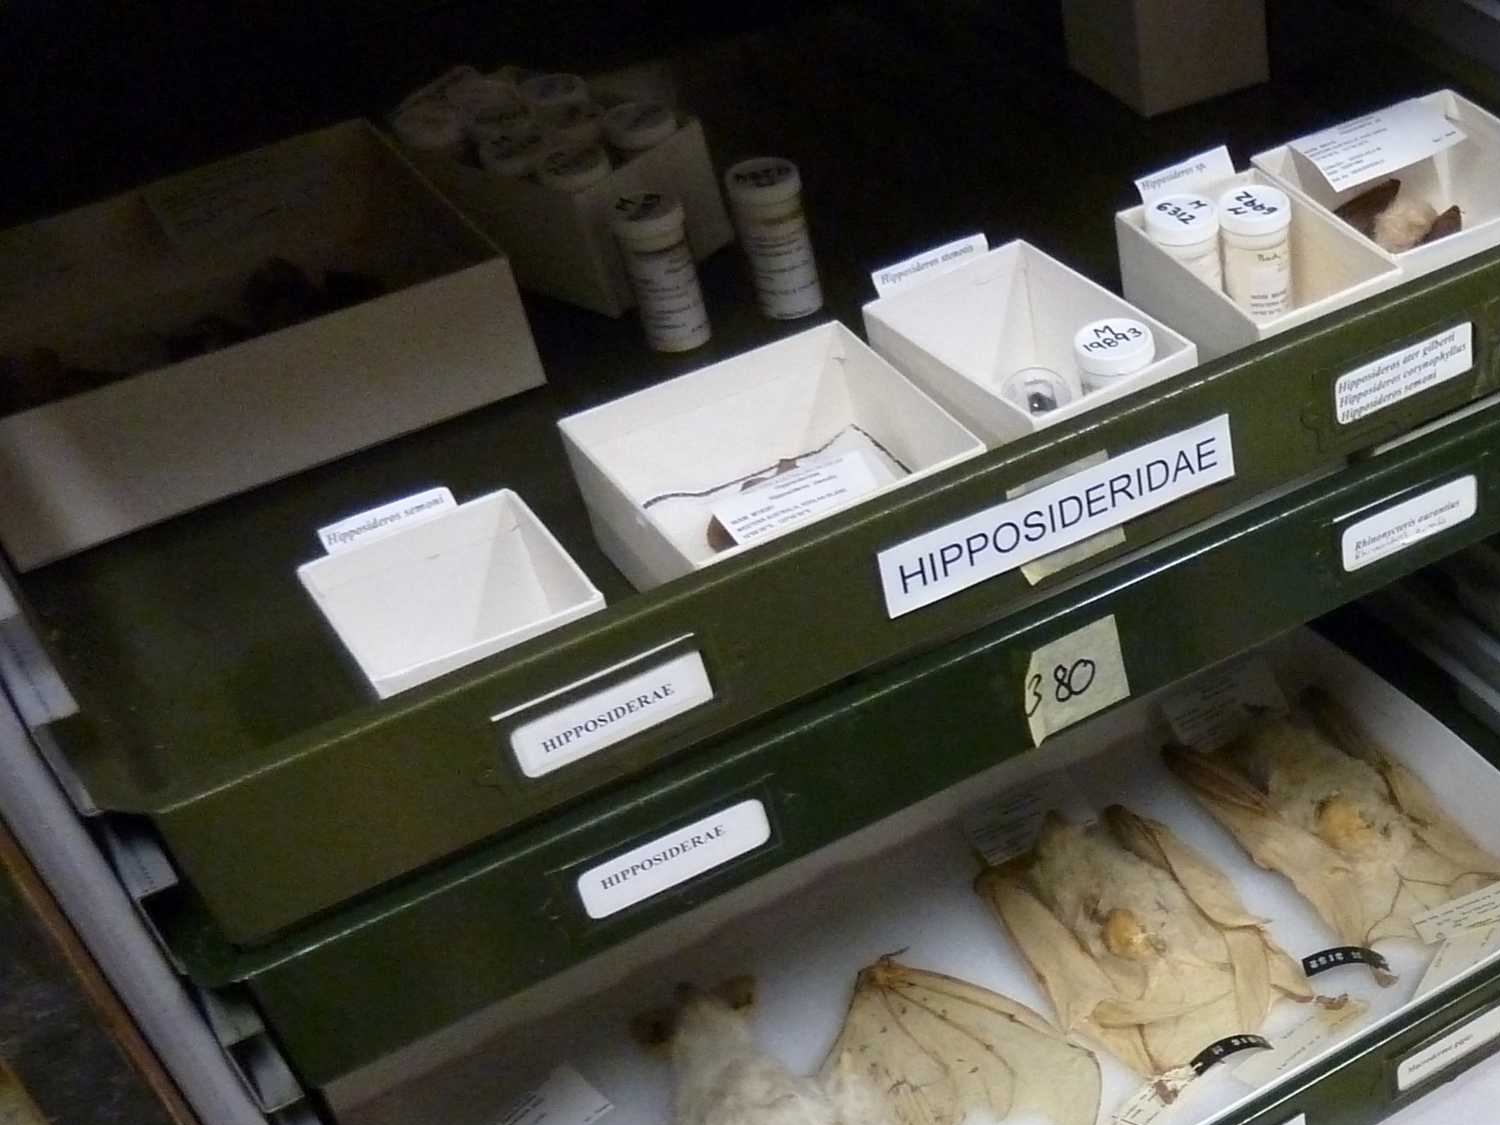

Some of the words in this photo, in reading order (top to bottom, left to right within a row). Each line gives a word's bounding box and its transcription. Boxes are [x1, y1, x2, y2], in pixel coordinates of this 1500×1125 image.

[1156, 202, 1196, 225] 6312
[1083, 327, 1142, 352] 19893
[1093, 325, 1116, 339] M
[1339, 361, 1401, 393] Hipposideros
[1340, 374, 1401, 408] Hipposideros
[327, 511, 401, 546] Hipposideros
[899, 437, 1218, 594] HIPPOSIDERIDAE
[541, 683, 676, 753] HIPPOSIDERAE
[600, 824, 727, 890] HIPPOSIDERAE
